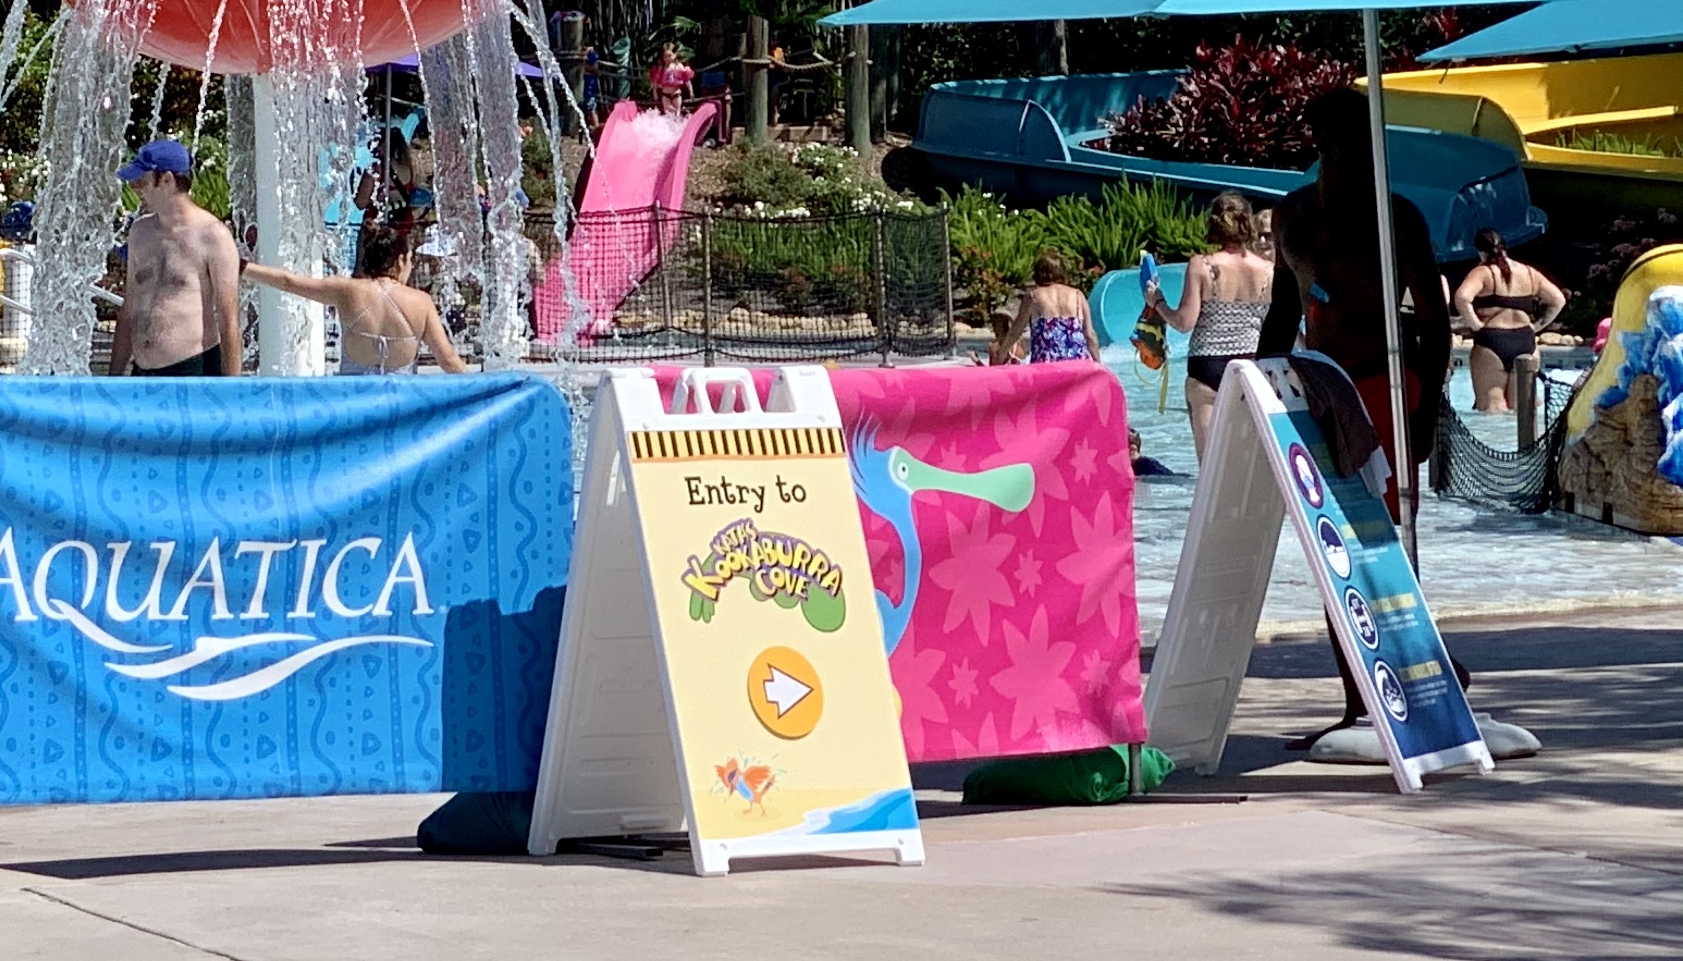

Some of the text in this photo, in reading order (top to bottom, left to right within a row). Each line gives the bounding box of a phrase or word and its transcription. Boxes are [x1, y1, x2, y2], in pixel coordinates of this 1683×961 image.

[685, 474, 807, 513] Entry to
[683, 537, 844, 601] KOOKABURRA
[754, 566, 812, 600] COVE
